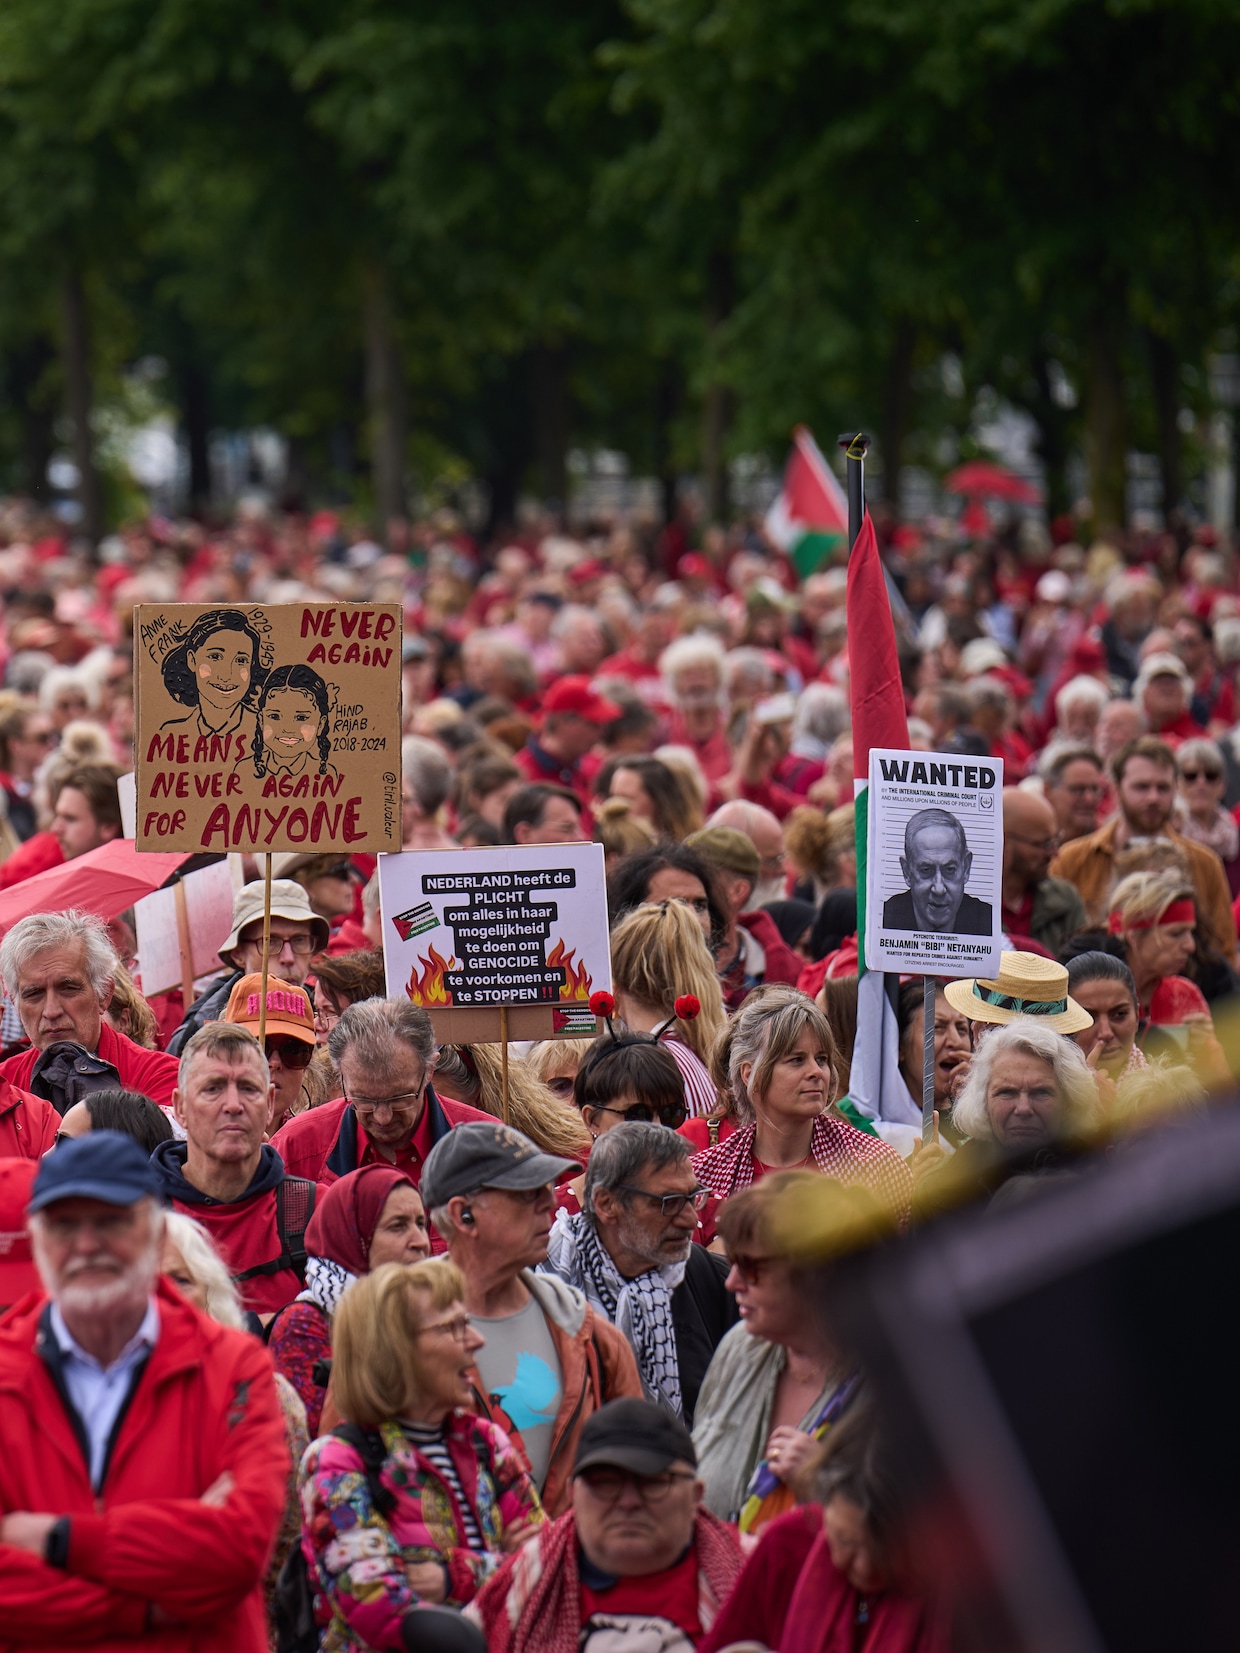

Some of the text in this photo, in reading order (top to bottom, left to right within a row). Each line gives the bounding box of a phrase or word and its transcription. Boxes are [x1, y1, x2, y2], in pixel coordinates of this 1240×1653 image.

[140, 614, 168, 647] ANNE
[300, 608, 396, 641] NEVER
[149, 619, 187, 664] FRANK
[146, 733, 247, 764] MEANS
[333, 737, 386, 752] 2018-2024
[879, 759, 996, 789] WANTED
[149, 772, 243, 798] NEVER
[899, 788, 936, 797] INTERNATIONAL
[937, 791, 960, 799] CRIMINAL
[144, 797, 368, 848] FOR ANYONE
[426, 872, 571, 889] NEDERLAND heeft de
[474, 891, 525, 904] PLICHT
[448, 906, 552, 921] om alles in haar
[458, 922, 545, 939] mogelijkheid
[465, 941, 539, 953] te doen om
[880, 938, 919, 950] BENJAMIN
[947, 943, 992, 955] NETANYAHU
[468, 955, 539, 969] GENOCIDE
[448, 972, 561, 985] te voorkomen en
[457, 991, 472, 1002] te
[474, 988, 538, 1001] STOPPEN
